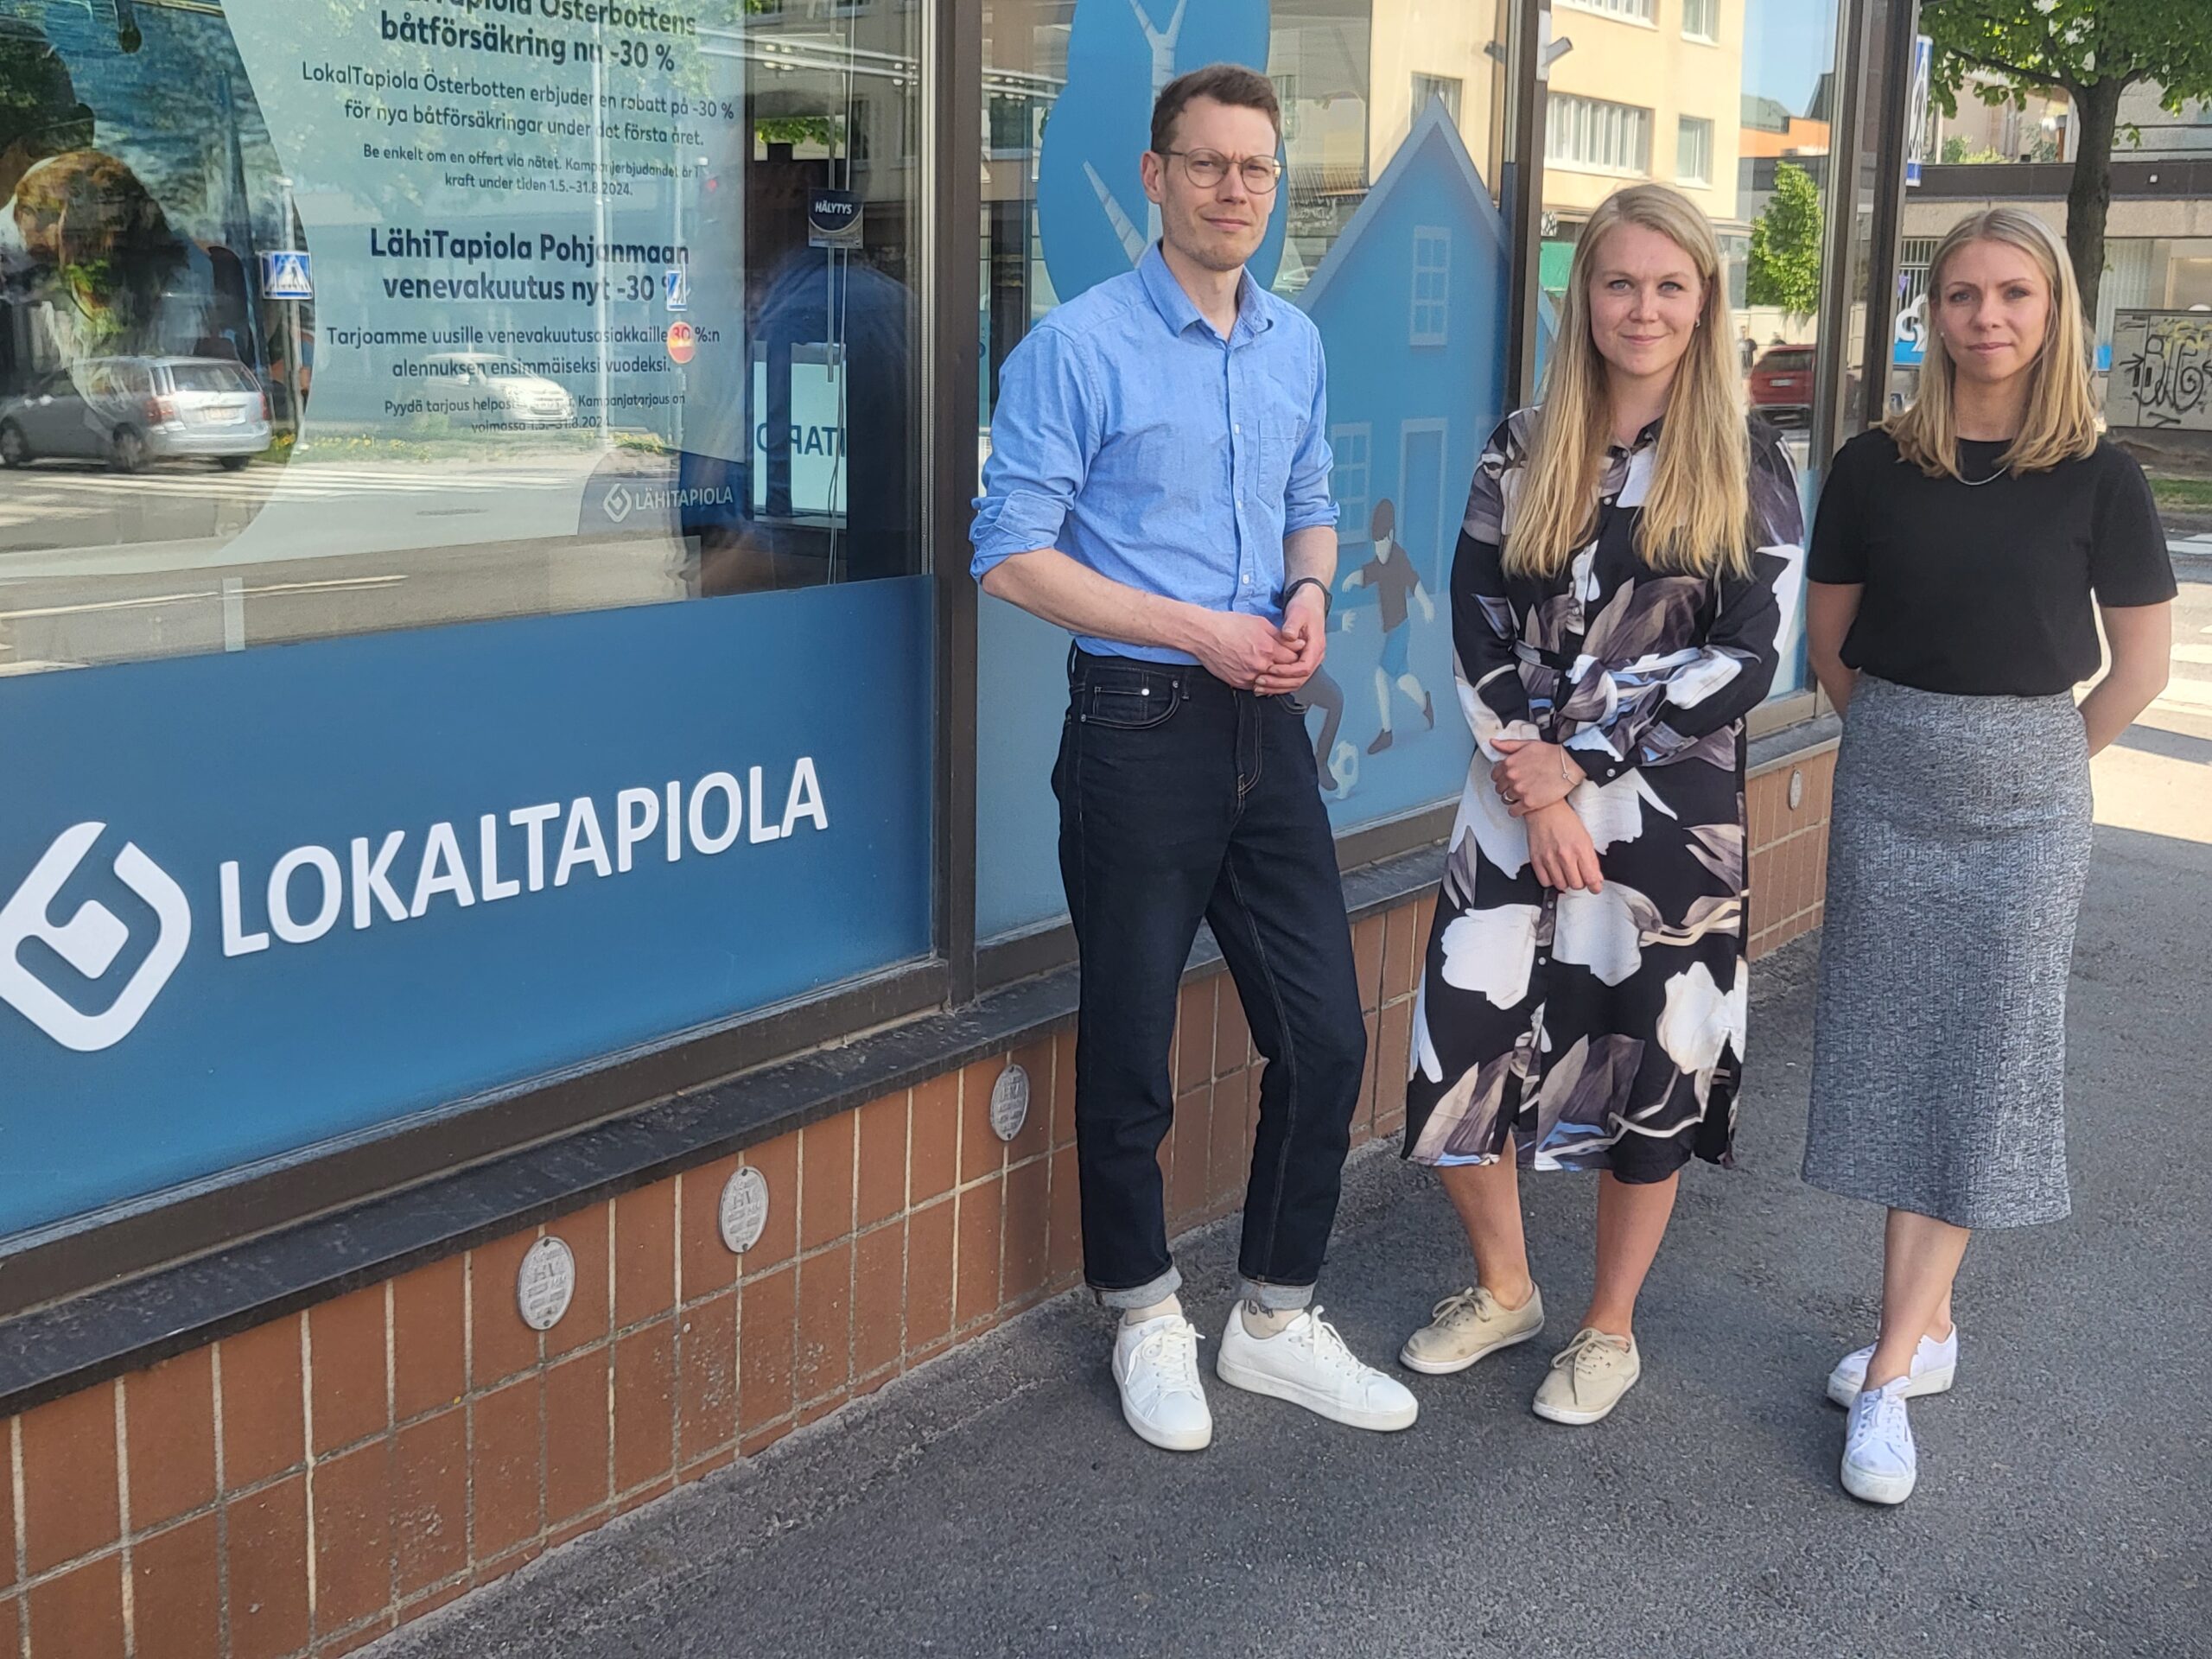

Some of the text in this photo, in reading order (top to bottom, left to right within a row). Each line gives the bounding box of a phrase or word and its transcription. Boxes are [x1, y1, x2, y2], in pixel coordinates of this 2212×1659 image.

[381, 10, 675, 72] båtförsäkring nu -30 %
[302, 61, 734, 119] LokalTapiola Österbotten erbjuder en rabatt på -30 %
[345, 99, 704, 146] för nya båtförsäkringar under det första året.
[364, 143, 379, 158] Be
[384, 146, 423, 162] enkelt
[427, 150, 446, 163] om
[450, 152, 465, 164] en
[468, 151, 503, 166] offert
[506, 154, 524, 168] via
[528, 155, 562, 170] nätet.
[445, 173, 475, 188] kraft
[480, 175, 513, 189] under
[516, 175, 546, 191] tiden
[815, 200, 853, 214] HÄLYTYS
[371, 227, 690, 268] LähiTapiola Pohjanmaan
[383, 271, 565, 301] venevakuutus
[572, 275, 610, 306] nyt
[617, 275, 654, 302] -30
[327, 326, 720, 349] Tarjoamme uusille venevakuutusasiakkaille 30 %:n
[392, 355, 671, 377] alennuksen ensimmäiseksi vuodeksi.
[385, 400, 423, 416] Pyydä
[426, 399, 470, 414] tarjous
[578, 393, 670, 410] Kampanjatarjous
[672, 394, 685, 404] on
[471, 419, 526, 434] voimassa
[635, 486, 734, 512] LÄHITAPIOLA
[219, 756, 829, 958] LOKALTAPIOLA
